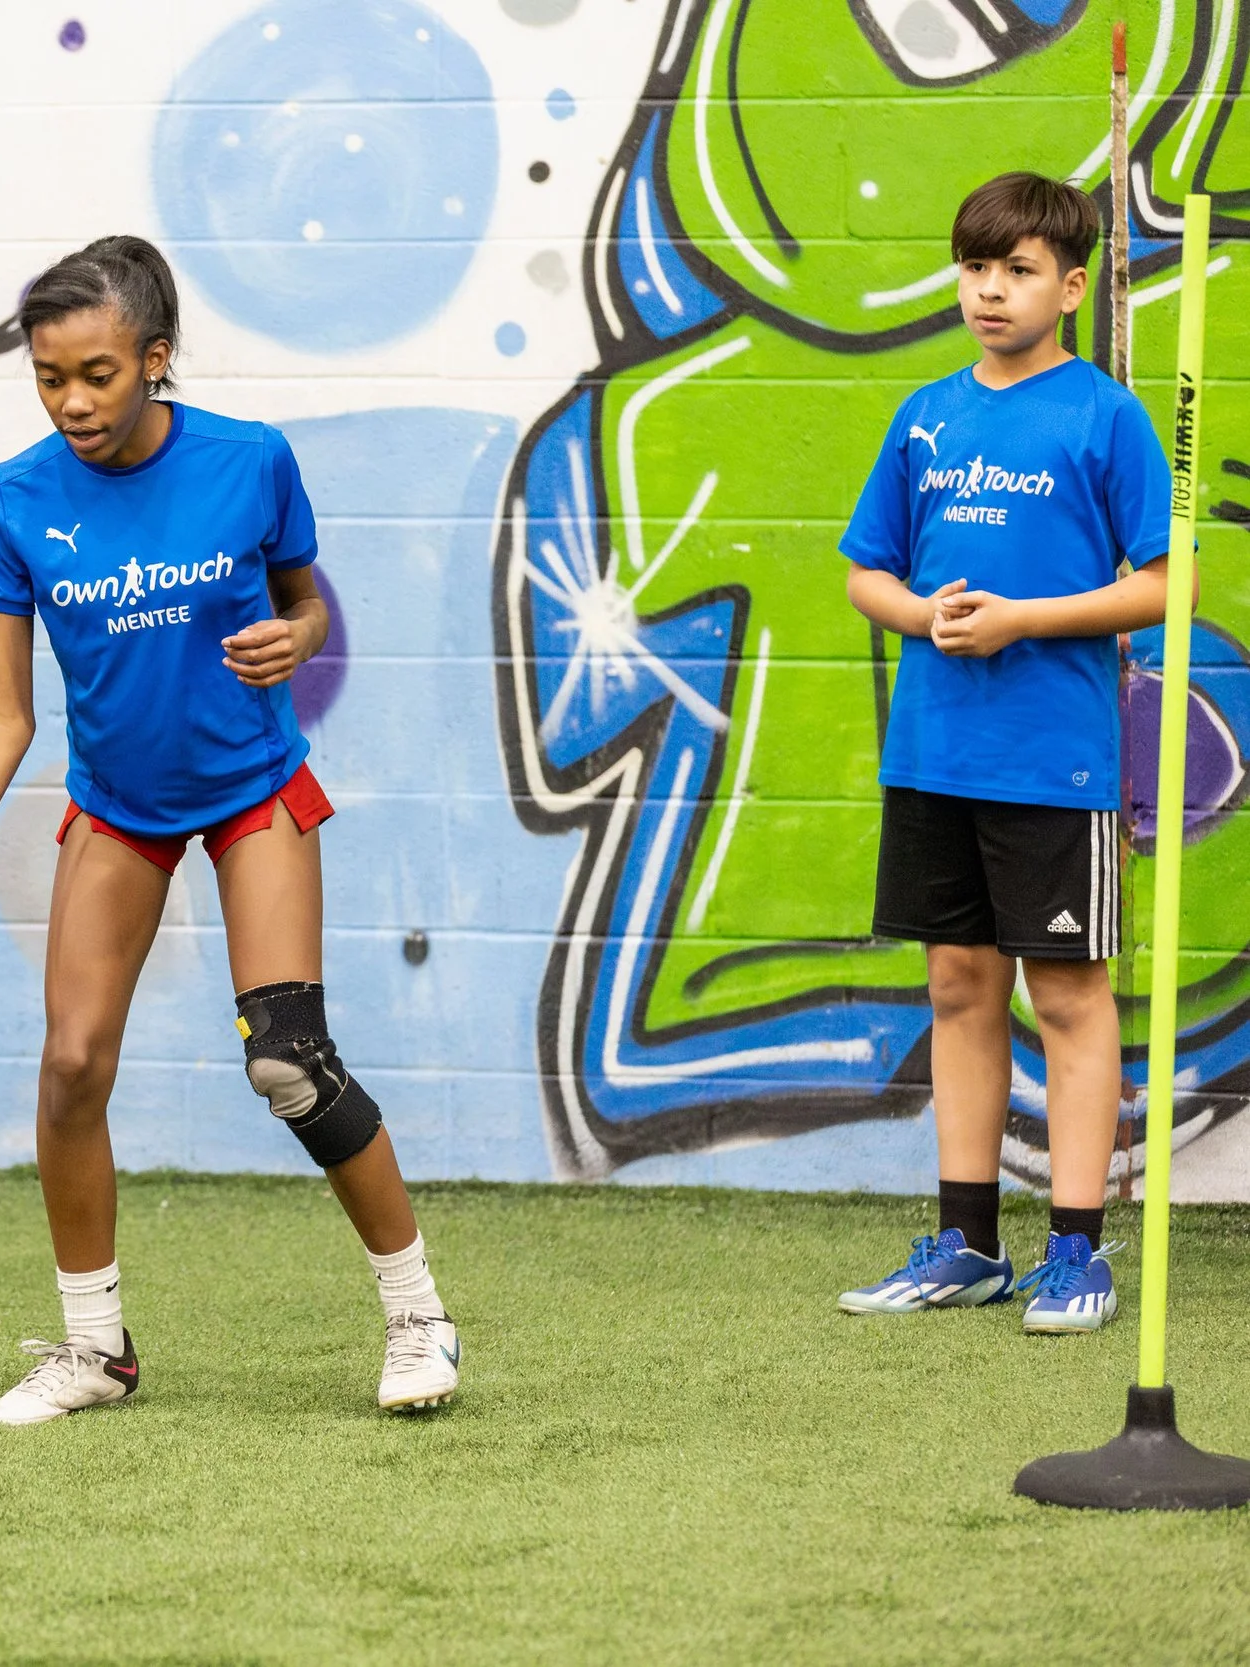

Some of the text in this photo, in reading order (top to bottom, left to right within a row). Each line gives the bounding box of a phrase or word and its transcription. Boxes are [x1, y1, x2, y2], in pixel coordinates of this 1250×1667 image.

[918, 465, 1055, 497] Own Touch
[943, 505, 1008, 526] MENTEE
[51, 551, 234, 607] Own Touch
[107, 605, 192, 635] MENTEE
[1047, 923, 1082, 934] adidas
